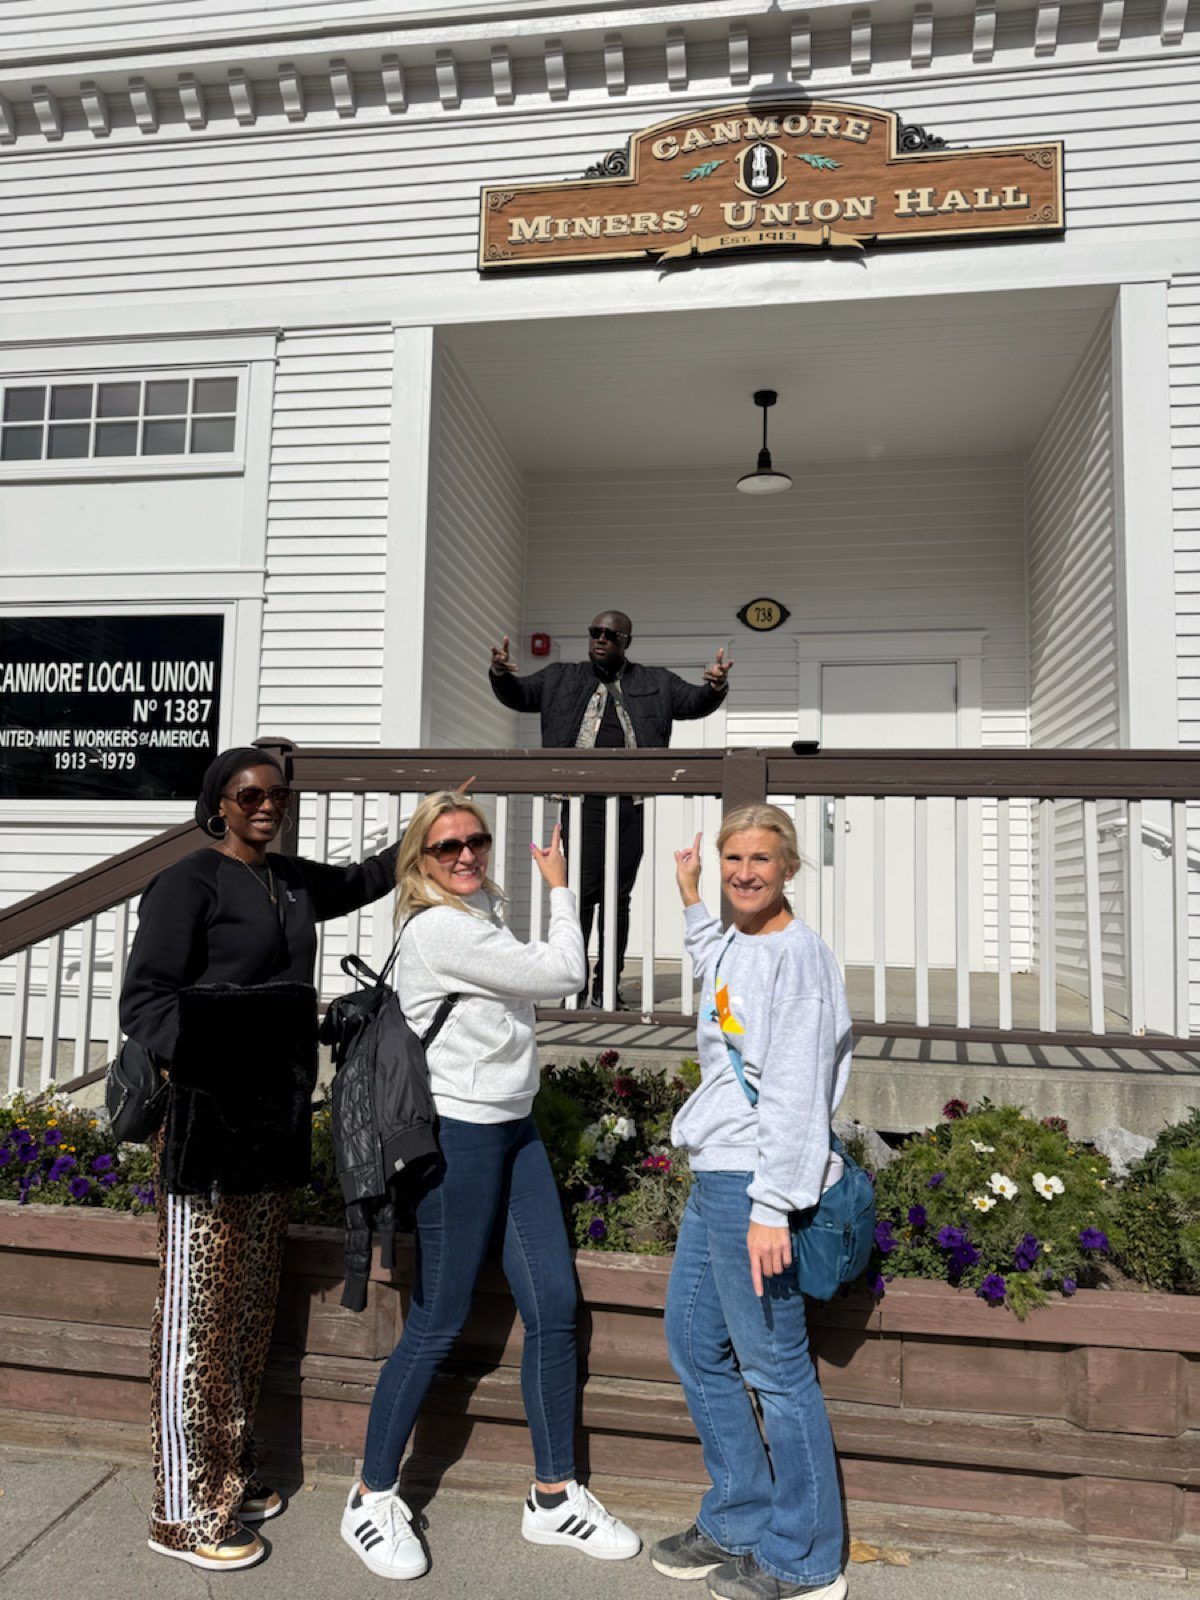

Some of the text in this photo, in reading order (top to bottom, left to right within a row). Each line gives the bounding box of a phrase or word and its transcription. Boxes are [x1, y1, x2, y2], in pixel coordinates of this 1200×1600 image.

[650, 114, 873, 160] CANMORE
[720, 196, 876, 230] UNION
[894, 186, 1030, 217] HALL
[759, 231, 797, 241] 1913
[755, 607, 773, 622] 738
[88, 661, 146, 693] LOCAL
[151, 661, 214, 693] UNION
[164, 698, 213, 723] 1387
[0, 730, 34, 747] NITED
[36, 730, 71, 747] MINE
[74, 730, 138, 747] WORKERS
[149, 729, 210, 748] AMERICA
